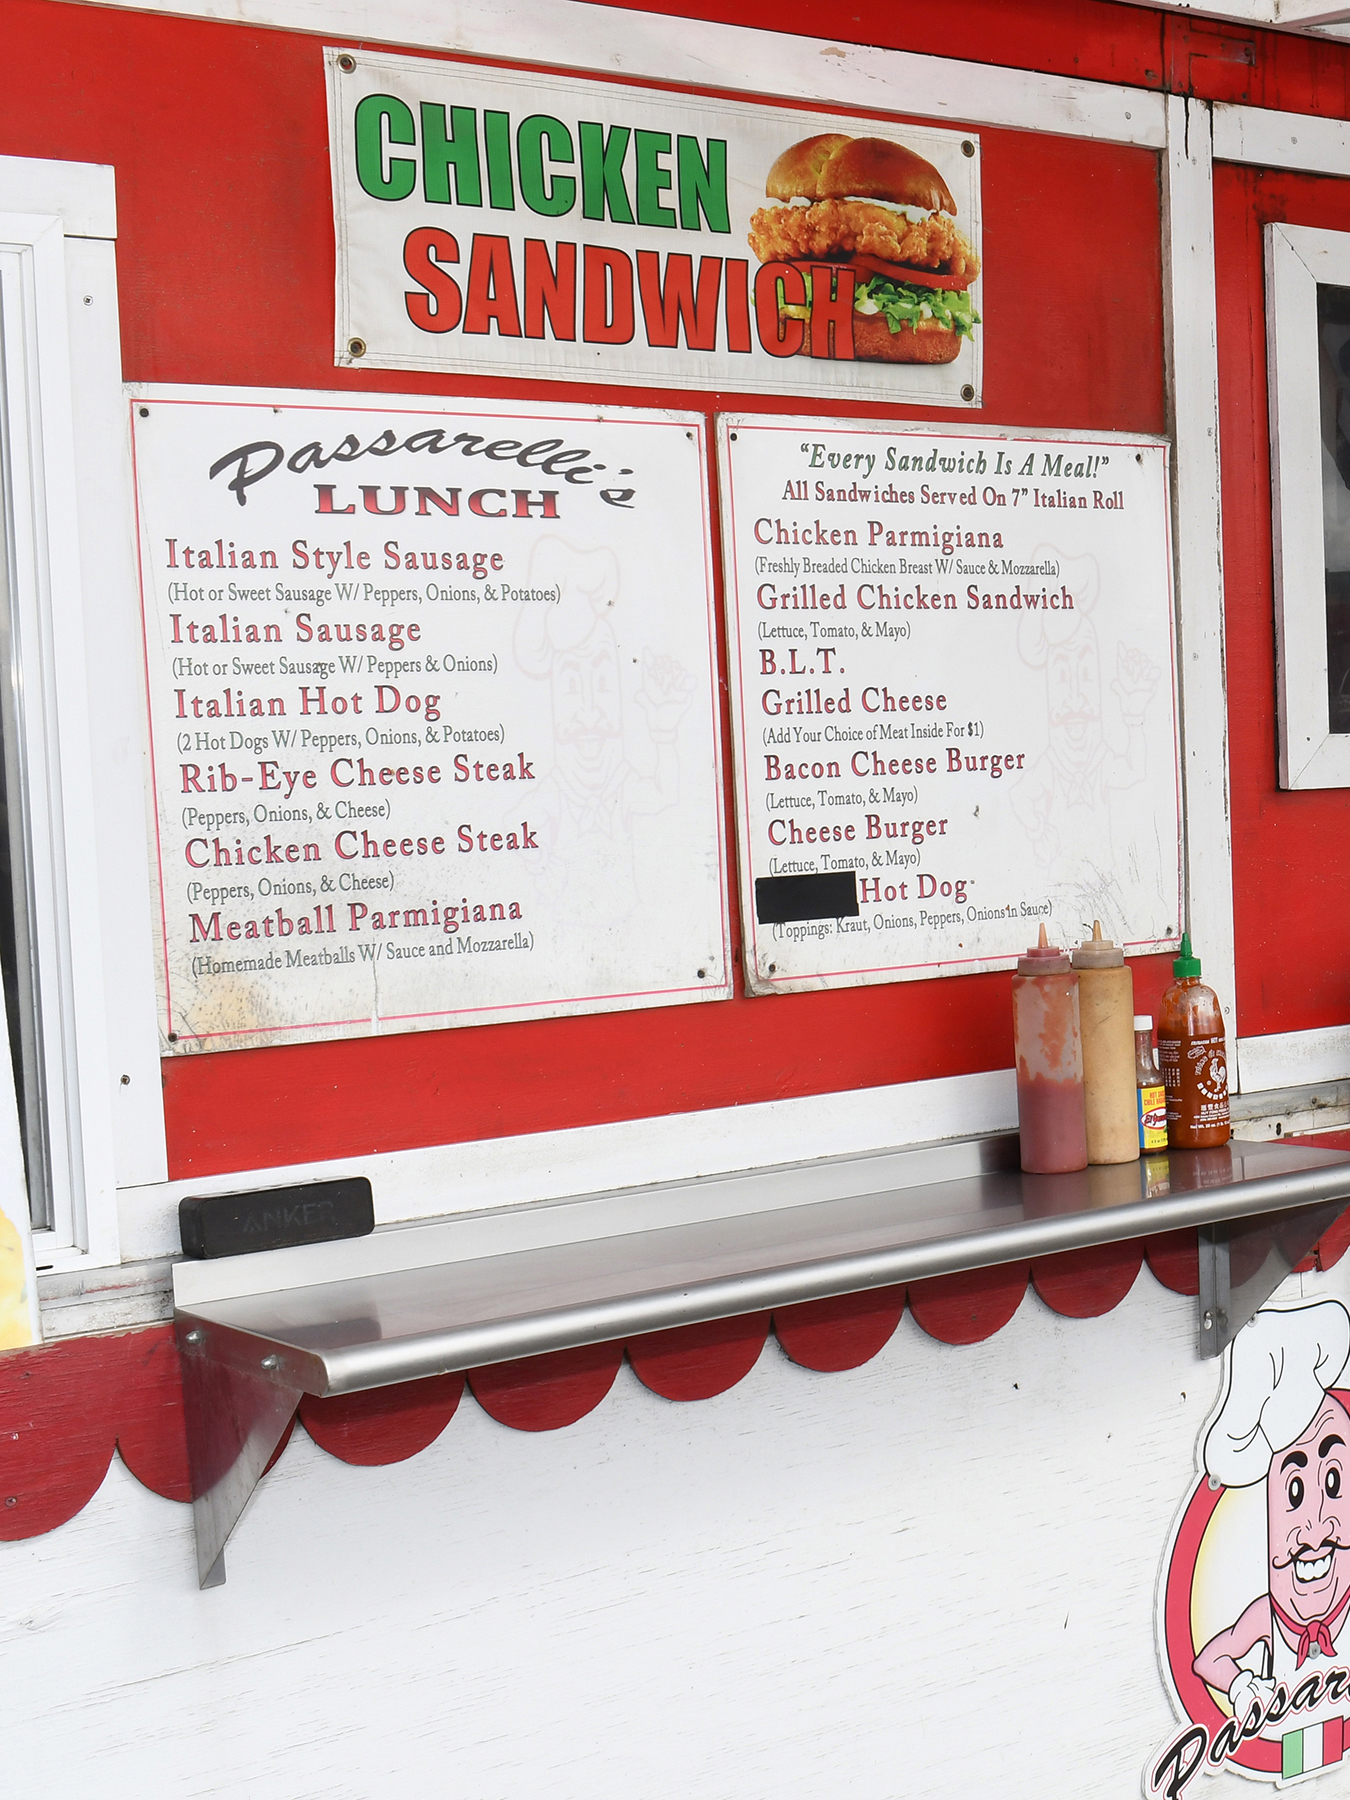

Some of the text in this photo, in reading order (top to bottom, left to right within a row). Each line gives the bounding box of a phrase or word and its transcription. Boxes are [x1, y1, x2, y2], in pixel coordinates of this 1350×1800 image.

[355, 93, 731, 233] CHICKEN
[403, 227, 857, 360] SANDWICH
[209, 429, 636, 508] Passarelli's
[885, 447, 987, 474] Sandwich
[994, 452, 1012, 475] Is
[1018, 453, 1034, 475] A
[313, 484, 560, 519] LUNCH
[782, 480, 809, 500] All
[815, 481, 915, 504] Sandwiches
[921, 484, 977, 505] Served
[983, 487, 1006, 506] On
[1033, 488, 1087, 508] Italian
[1093, 490, 1124, 509] Roll
[754, 518, 1004, 555] Chicken Parmigiana
[165, 539, 503, 580] Italian Style Sausage
[755, 556, 1059, 578] (Freshly Breaded Chicken Breast W/ Sauce & Mozzarella)
[168, 582, 560, 607] (Hot or Sweet Sausage W/ Peppers, Onions, & Potatoes)
[757, 583, 1074, 610] Grilled Chicken Sandwich
[169, 613, 421, 651] Italian Sausage
[758, 621, 910, 642] (Lettuce, Tomato, & Mayo)
[173, 654, 497, 679] (Hot or Sweet Sausage W/ Peppers & Onions)
[759, 647, 844, 675] B.L.T.
[174, 685, 440, 722] Italian Hot Dog
[762, 687, 947, 715] Grilled Cheese
[178, 724, 504, 755] (2 Hot Dogs W/ Peppers, Onions, & Potatoes)
[763, 721, 983, 747] (Add Your Choice of Meat Inside For $1)
[179, 752, 535, 799] Rib-Eye Cheese Steak
[764, 748, 1025, 780] Bacon Cheese Burger
[766, 786, 917, 812] (Lettuce, Tomato, & Mayo)
[182, 799, 390, 831] (Peppers, Onions, & Cheese)
[768, 814, 948, 845] Cheese Burger
[185, 821, 539, 868] Chicken Cheese Steak
[769, 848, 920, 875] (Lettuce, Tomato, & Mayo)
[187, 870, 394, 905] (Peppers, Onions, & Cheese)
[859, 874, 967, 904] Hot Dog
[189, 898, 522, 943] Meatball Parmigiana
[772, 921, 832, 942] (Toppings:
[836, 916, 871, 935] Kraut,
[874, 914, 917, 929] Onions,
[919, 910, 964, 929] Peppers,
[967, 906, 1005, 921] Onions
[1020, 899, 1052, 916] Sauce)
[192, 931, 533, 978] (Homemade Meatballs W/ Sauce and Mozzarella)
[243, 1202, 335, 1232] ANKER
